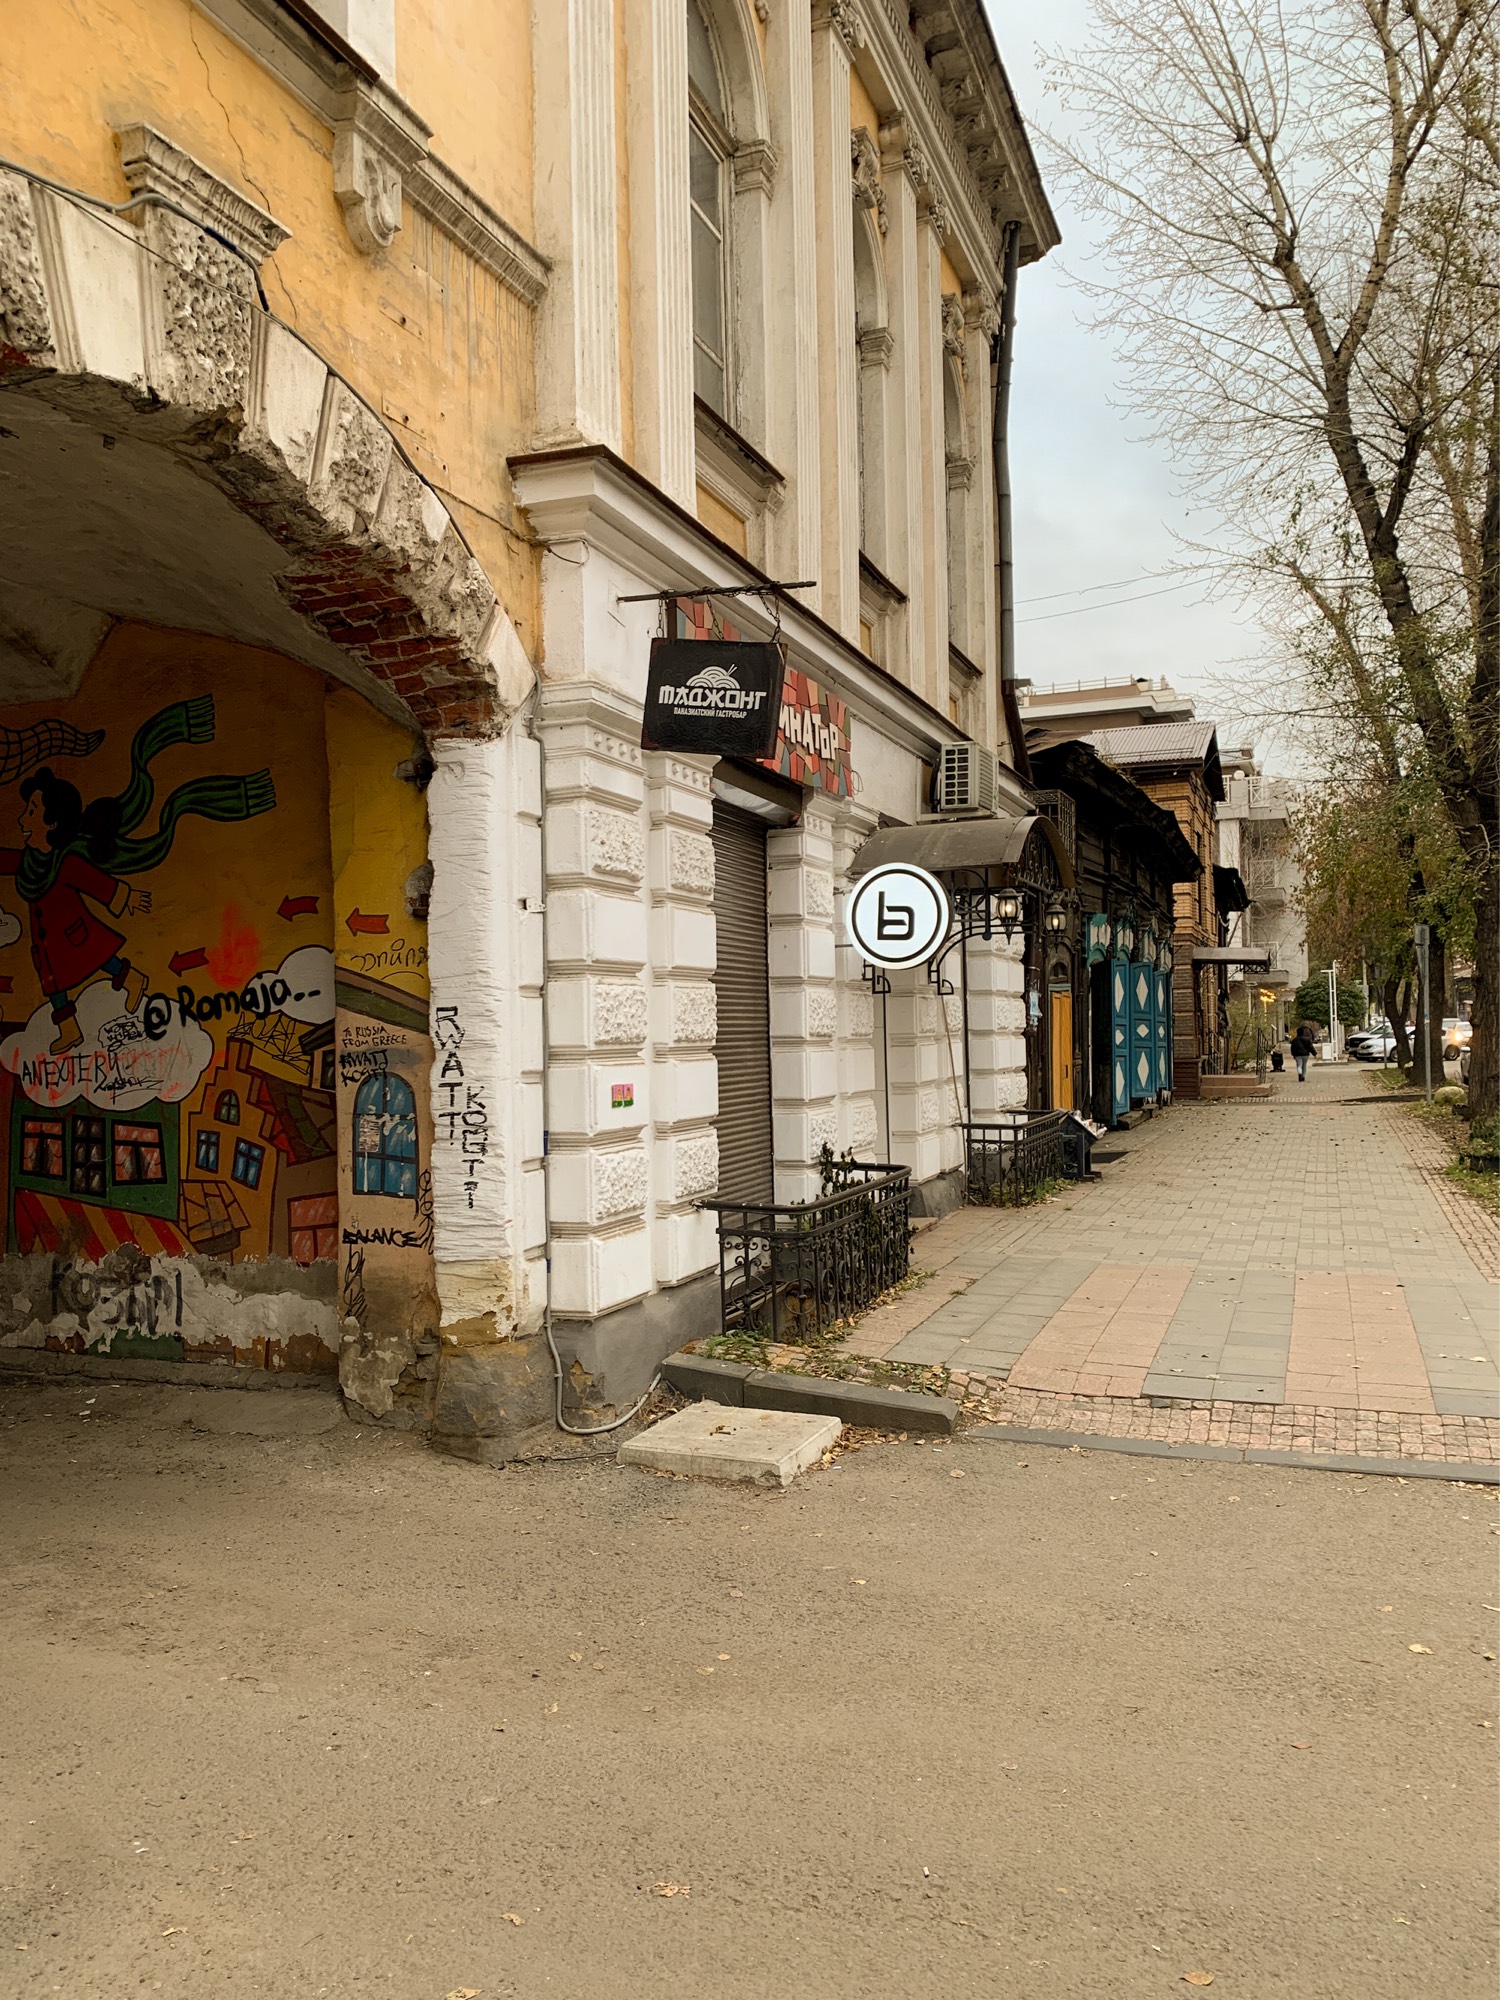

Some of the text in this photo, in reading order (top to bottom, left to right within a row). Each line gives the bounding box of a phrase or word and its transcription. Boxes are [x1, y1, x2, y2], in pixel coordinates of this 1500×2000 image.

[658, 685, 767, 709] МАДЖОНГ
[673, 706, 748, 718] ПАНАЗИАТСКИЙ ГАСТРОБАР
[342, 1035, 407, 1048] FROM GREECE
